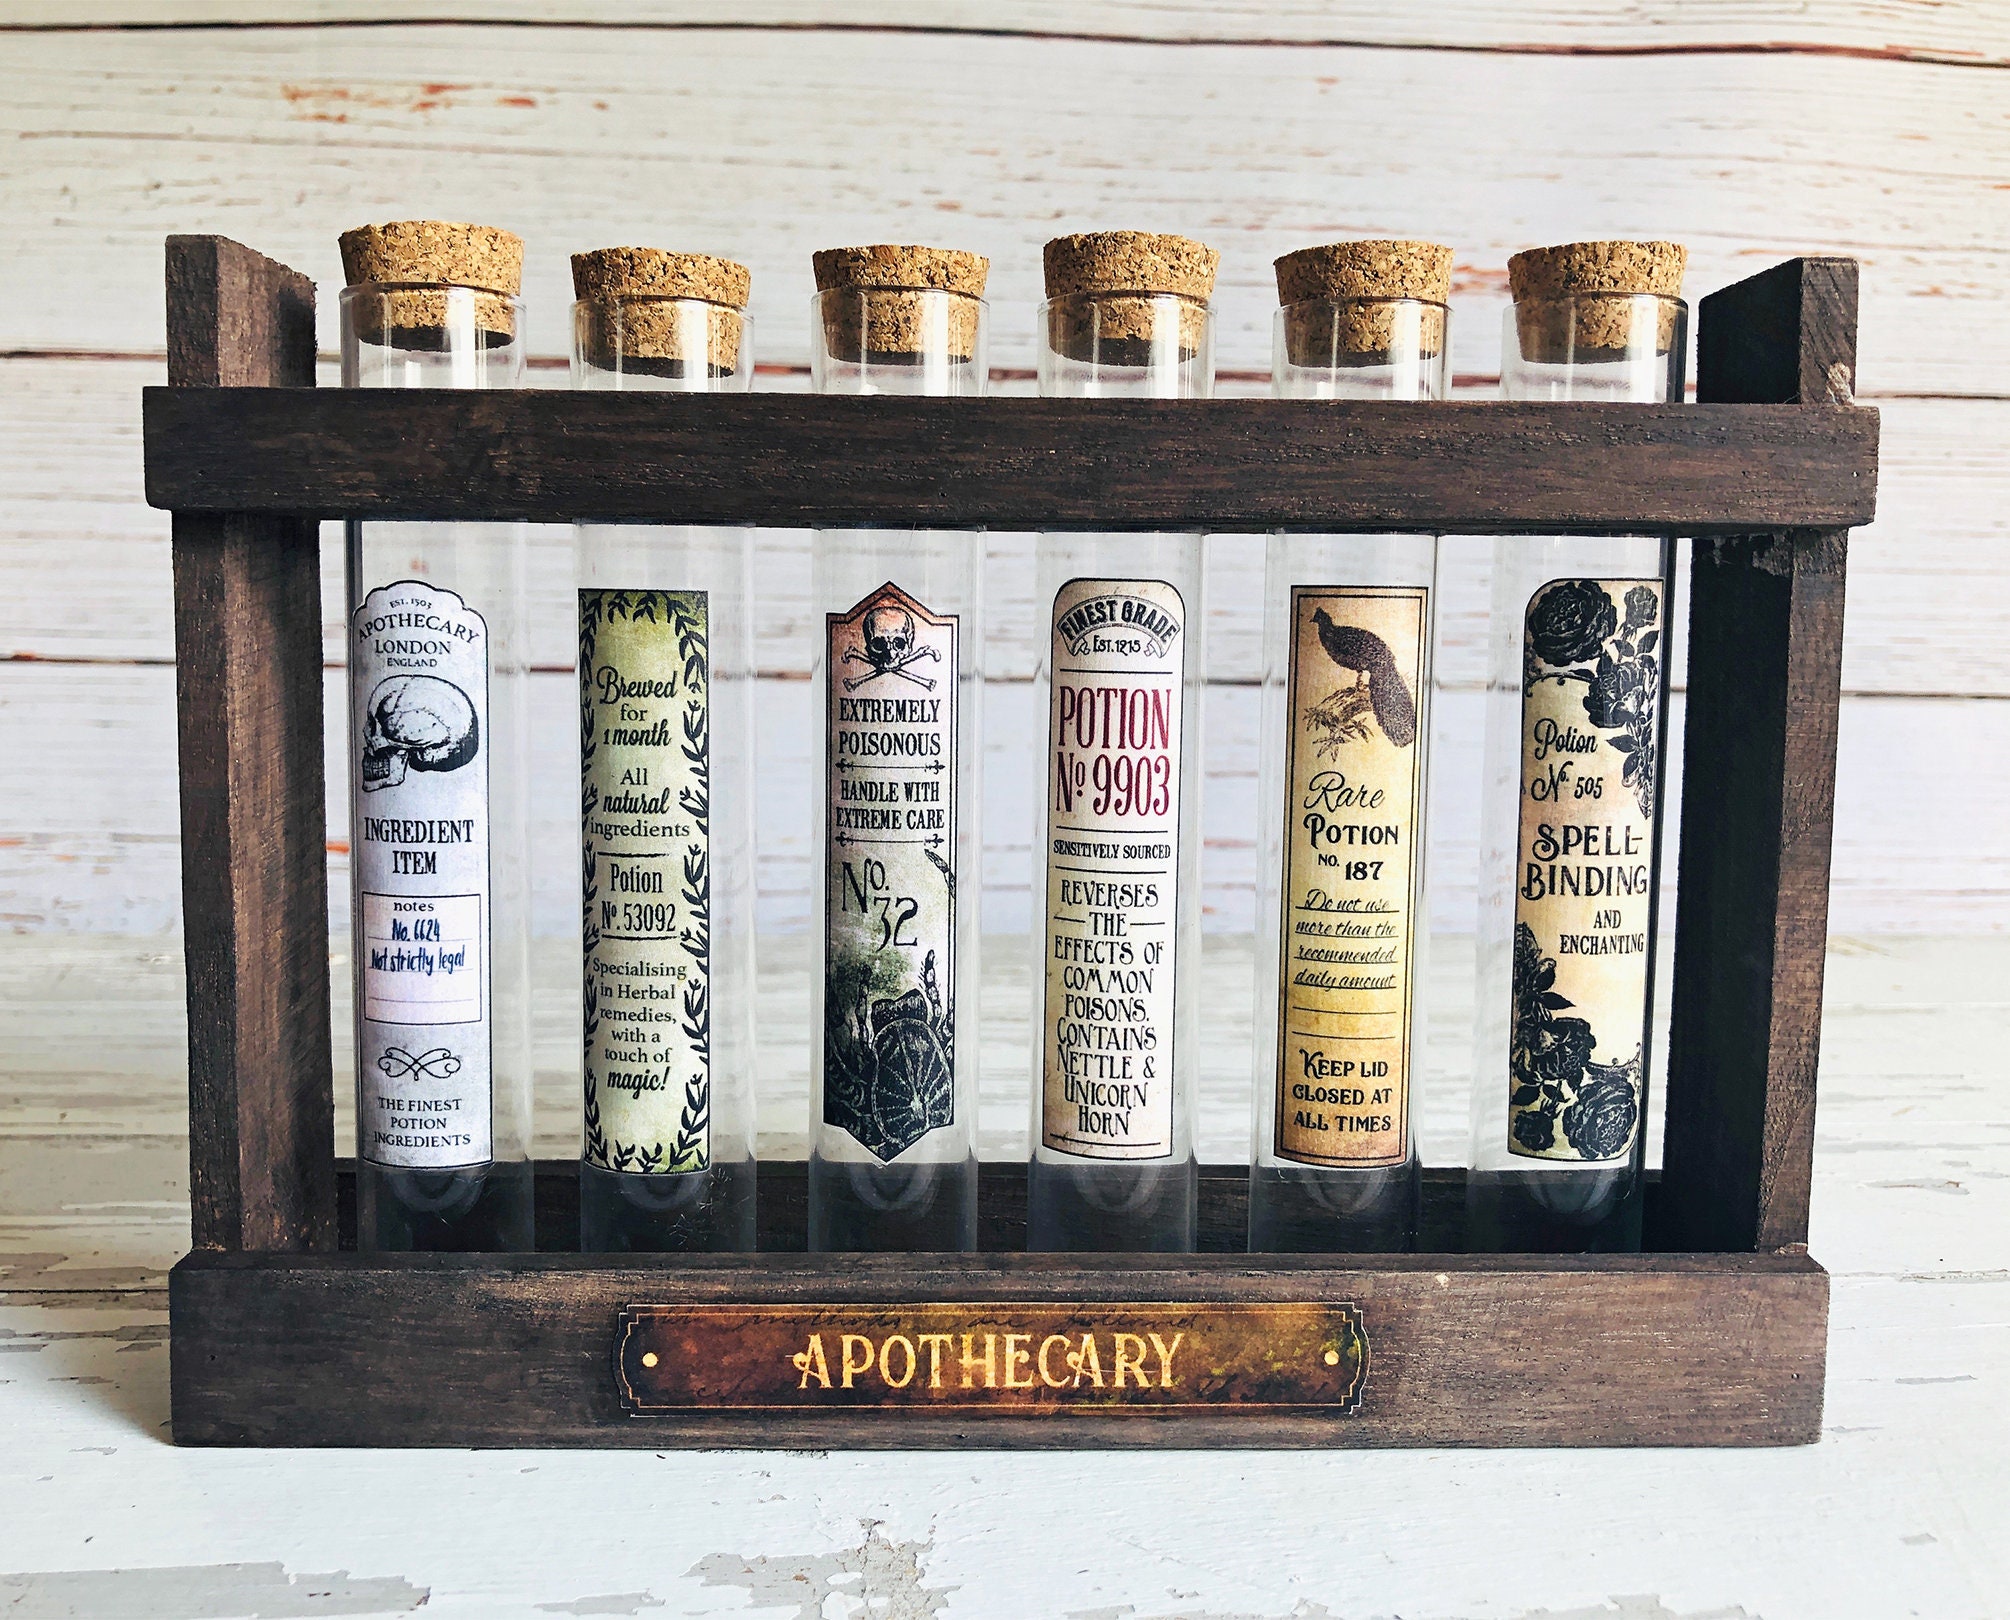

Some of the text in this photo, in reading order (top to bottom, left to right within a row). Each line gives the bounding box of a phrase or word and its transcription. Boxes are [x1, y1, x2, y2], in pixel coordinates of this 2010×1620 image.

[389, 597, 432, 610] EST. 1503
[359, 613, 480, 644] APOTHECARY
[1060, 600, 1177, 643] FINEST GRADE
[375, 639, 452, 655] LONDON
[387, 657, 438, 668] ENGLAND
[596, 665, 679, 704] Brewed
[620, 703, 648, 722] for
[838, 698, 941, 723] EXTREMELY
[1057, 686, 1172, 750] POTION
[838, 731, 941, 756] POISONOUS
[1533, 717, 1598, 760] Potion
[620, 768, 648, 786] All
[1093, 754, 1171, 816] 9903
[1574, 776, 1604, 799] 505
[602, 787, 671, 815] natural
[840, 779, 940, 802] HANDLE WITH
[1303, 770, 1386, 813] Rare
[364, 816, 474, 844] INGREDIENT
[590, 816, 690, 841] ingredients
[836, 806, 945, 830] EXTREME CARE
[1302, 812, 1399, 850] POTION
[1532, 824, 1643, 862] SPELL-
[1053, 838, 1171, 860] SENSITIVELY SOURCED
[392, 850, 437, 875] ITEM
[1345, 861, 1385, 881] 187
[610, 863, 664, 893] Potion
[1521, 862, 1648, 901] BINDING
[393, 902, 435, 912] notes
[1061, 879, 1159, 910] REVERSES
[1303, 888, 1390, 912] Do not use
[391, 918, 440, 942] No. 6624
[1089, 912, 1127, 937] THE
[1296, 919, 1397, 936] more than the
[1593, 909, 1622, 929] AND
[1054, 935, 1165, 965] EFFECTS OF
[1296, 945, 1397, 963] recommended
[1559, 932, 1644, 955] ENCHANTING
[371, 944, 466, 976] Not strictly legal
[592, 957, 688, 981] Specialising
[600, 982, 675, 1000] in Herbal
[1063, 965, 1154, 994] COMMON
[1294, 968, 1396, 992] daily amount
[600, 1006, 677, 1024] remedies,
[1065, 993, 1150, 1022] POISONS.
[611, 1027, 661, 1043] with a
[1056, 1016, 1157, 1050] CONTAINS
[604, 1047, 673, 1063] touch of
[1056, 1044, 1157, 1079] NETTLE &
[1299, 1048, 1389, 1080] KEEP LID
[607, 1066, 671, 1100] magic!
[1064, 1074, 1149, 1110] UNICORN
[1292, 1083, 1393, 1105] CLOSED AT
[378, 1096, 463, 1112] THE FINEST
[390, 1116, 447, 1130] POTION
[1078, 1105, 1131, 1138] HORN
[1293, 1110, 1392, 1133] ALL TIMES
[374, 1131, 471, 1148] INGREDIENTS
[791, 1333, 1185, 1389] APOTHECARY
